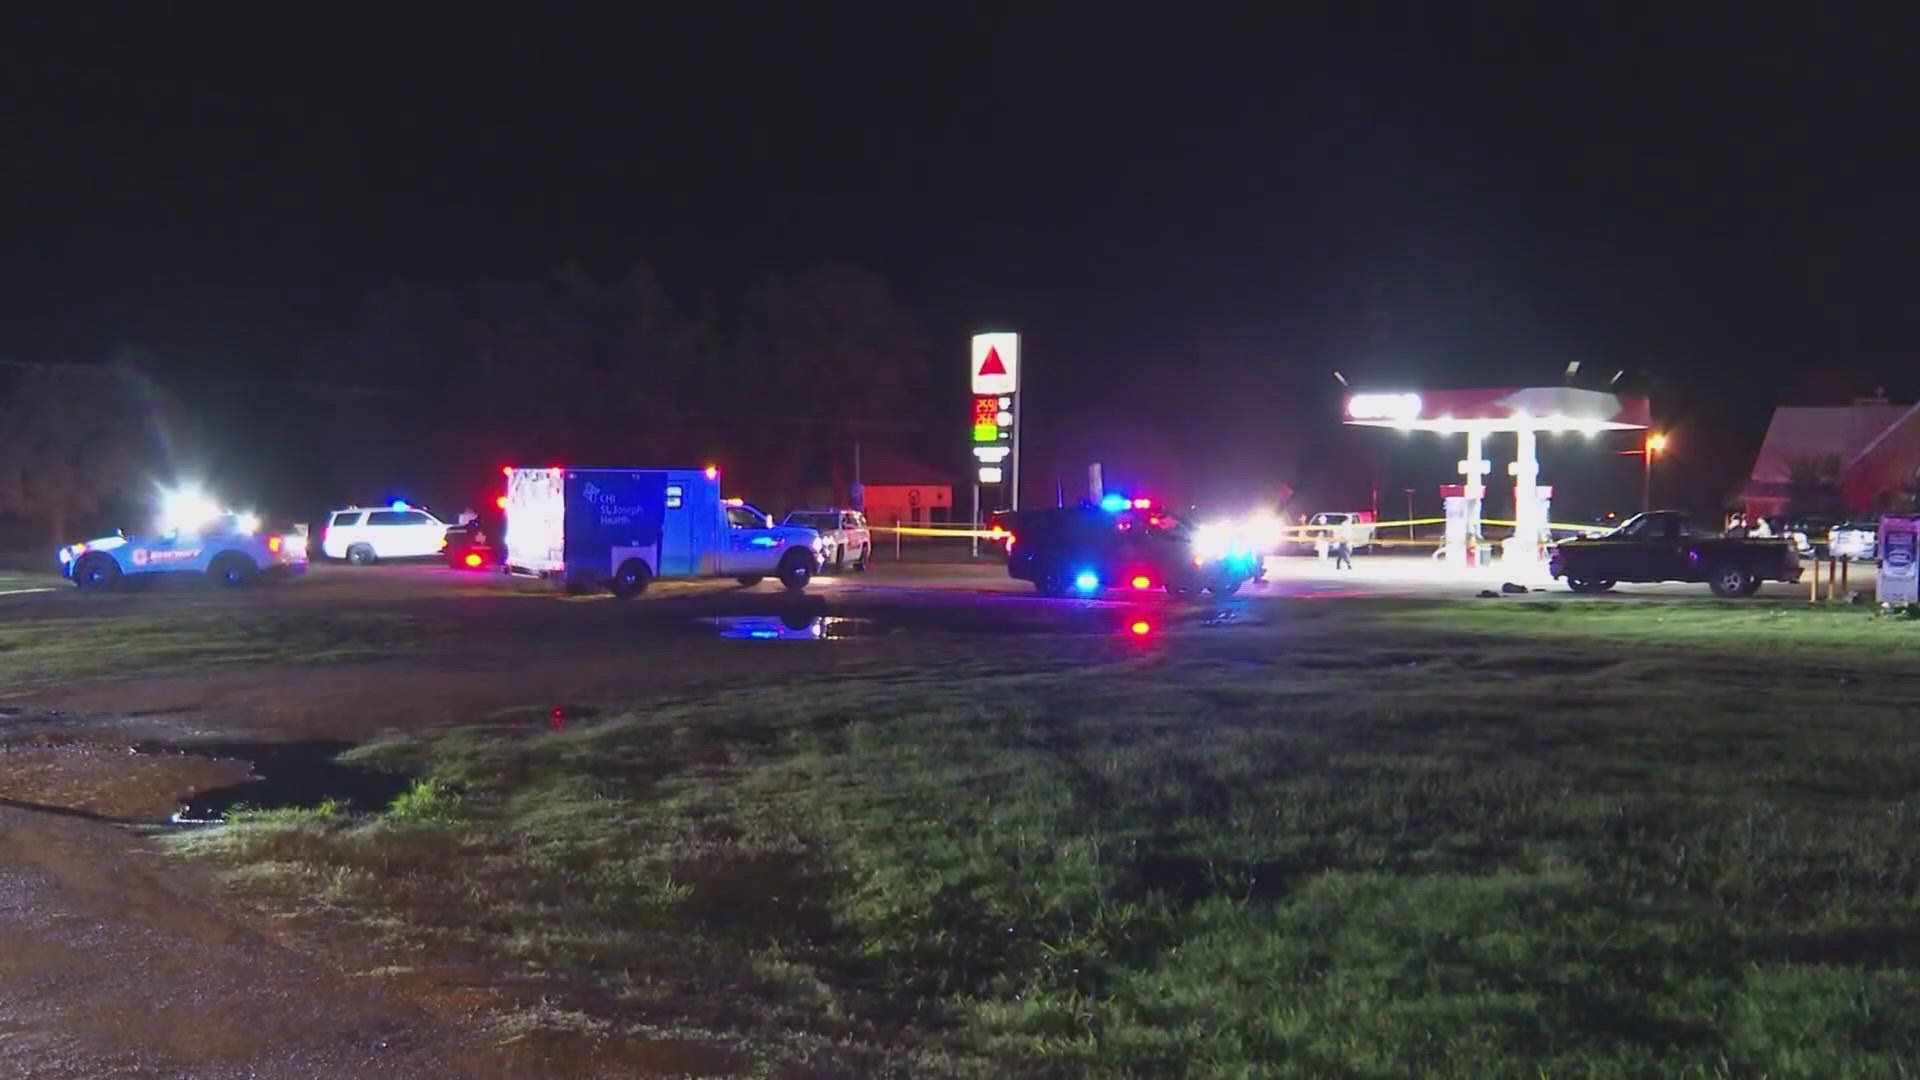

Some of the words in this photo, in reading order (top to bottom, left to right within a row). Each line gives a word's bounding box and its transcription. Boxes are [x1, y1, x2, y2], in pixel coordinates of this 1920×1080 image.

[599, 494, 616, 504] CHI
[613, 504, 644, 516] Joseph
[600, 515, 630, 525] Health
